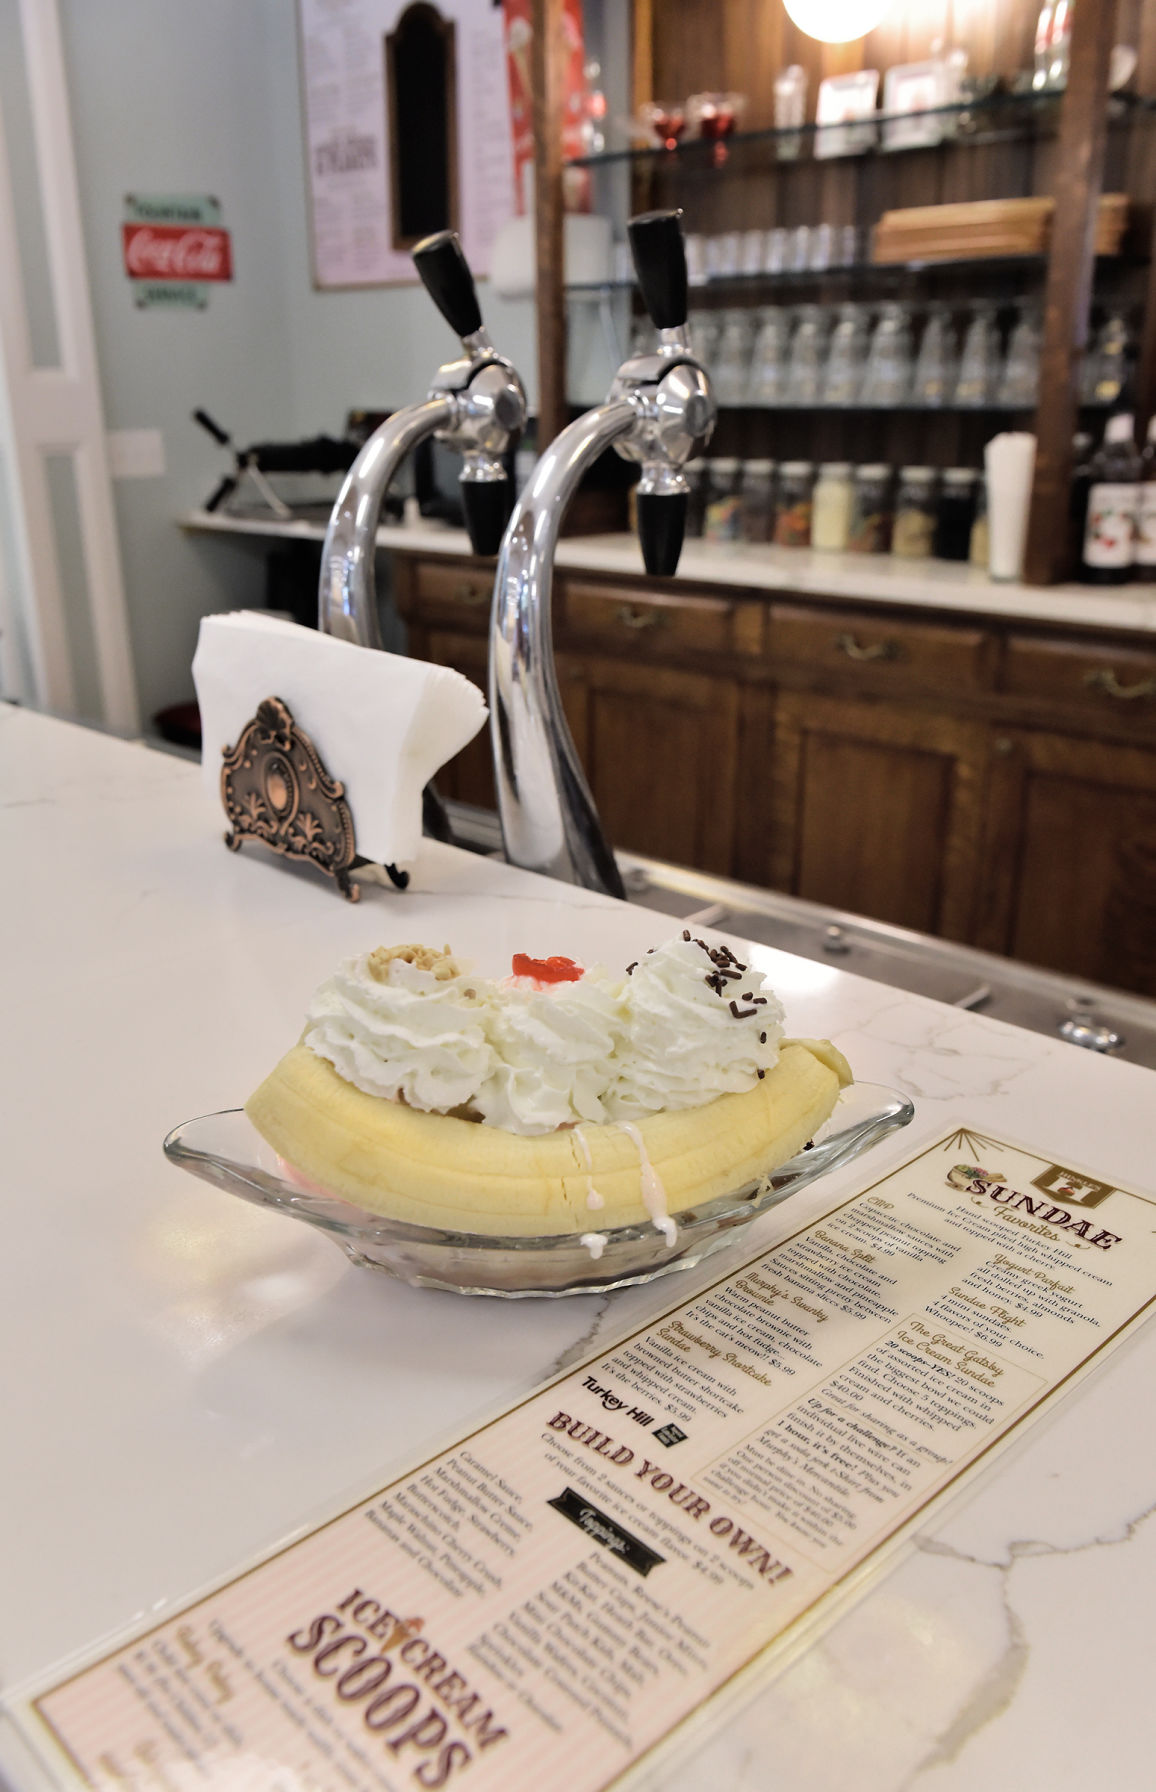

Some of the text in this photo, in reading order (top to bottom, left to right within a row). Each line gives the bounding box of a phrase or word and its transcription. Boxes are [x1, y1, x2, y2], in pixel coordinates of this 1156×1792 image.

[965, 1178, 1121, 1249] SUNDAE
[992, 1205, 1061, 1241] Favorites
[786, 1247, 819, 1265] topped
[817, 1263, 837, 1275] with
[795, 1242, 881, 1287] strawberry ice cream
[813, 1229, 876, 1264] Banana Split
[835, 1252, 878, 1275] chocolate
[877, 1274, 898, 1285] and
[734, 1279, 775, 1306] Brownie
[741, 1271, 829, 1323] Murphy's Swanky
[760, 1263, 783, 1277] fresh
[782, 1274, 815, 1294] banana
[815, 1292, 839, 1307] slices
[769, 1257, 892, 1323] Sauces sitting pretty between
[778, 1252, 899, 1315] marshmallow and pineapple
[969, 1271, 994, 1286] fresh
[1031, 1302, 1074, 1324] almonds
[984, 1260, 1083, 1308] Creamy greek yogurt
[989, 1253, 1074, 1294] Yogurt Parfait
[989, 1272, 1022, 1289] dolled
[1021, 1287, 1036, 1296] up
[1037, 1294, 1059, 1307] with
[694, 1305, 717, 1320] chips
[717, 1319, 738, 1330] and
[735, 1327, 753, 1340] hot
[713, 1293, 813, 1350] chocolate brownie with
[724, 1286, 809, 1336] Warm peanut butter
[924, 1305, 1003, 1347] Whoopee! $6.99
[939, 1303, 971, 1322] flavors
[972, 1320, 986, 1328] of
[984, 1326, 1008, 1340] your
[947, 1286, 1026, 1327] Sundae Flight
[655, 1327, 691, 1352] Sundae
[663, 1320, 772, 1386] Strawberry Shortcake
[684, 1310, 699, 1321] It's
[698, 1318, 715, 1329] the
[714, 1328, 734, 1341] cat's
[767, 1358, 796, 1375] $5.99
[704, 1299, 733, 1317] vanilla
[731, 1314, 747, 1324] ice
[777, 1340, 823, 1367] chocolate
[896, 1329, 995, 1387] Ice Cream Sundae
[909, 1320, 1004, 1377] The Great Gatsby
[611, 1357, 632, 1370] and
[629, 1367, 669, 1394] whipped
[622, 1350, 727, 1418] topped with strawberries
[632, 1342, 744, 1413] browned butter shortcake
[644, 1335, 737, 1396] Vanilla ice cream with
[866, 1353, 995, 1424] the biggest bowl we could
[875, 1346, 992, 1411] of assorted ice cream in
[881, 1372, 920, 1395] Choose
[919, 1393, 930, 1401] 5
[883, 1340, 899, 1349] 20
[953, 1376, 969, 1386] 20
[968, 1385, 1003, 1406] scoops
[580, 1375, 654, 1427] Turkey Hill
[848, 1366, 961, 1431] Finished with whipped
[546, 1411, 634, 1466] BUILD
[634, 1459, 711, 1519] YOUR
[707, 1516, 792, 1584] OWN!
[336, 1588, 402, 1640] ICE
[398, 1637, 508, 1750] CREAM
[288, 1612, 470, 1792] SCOOPS
